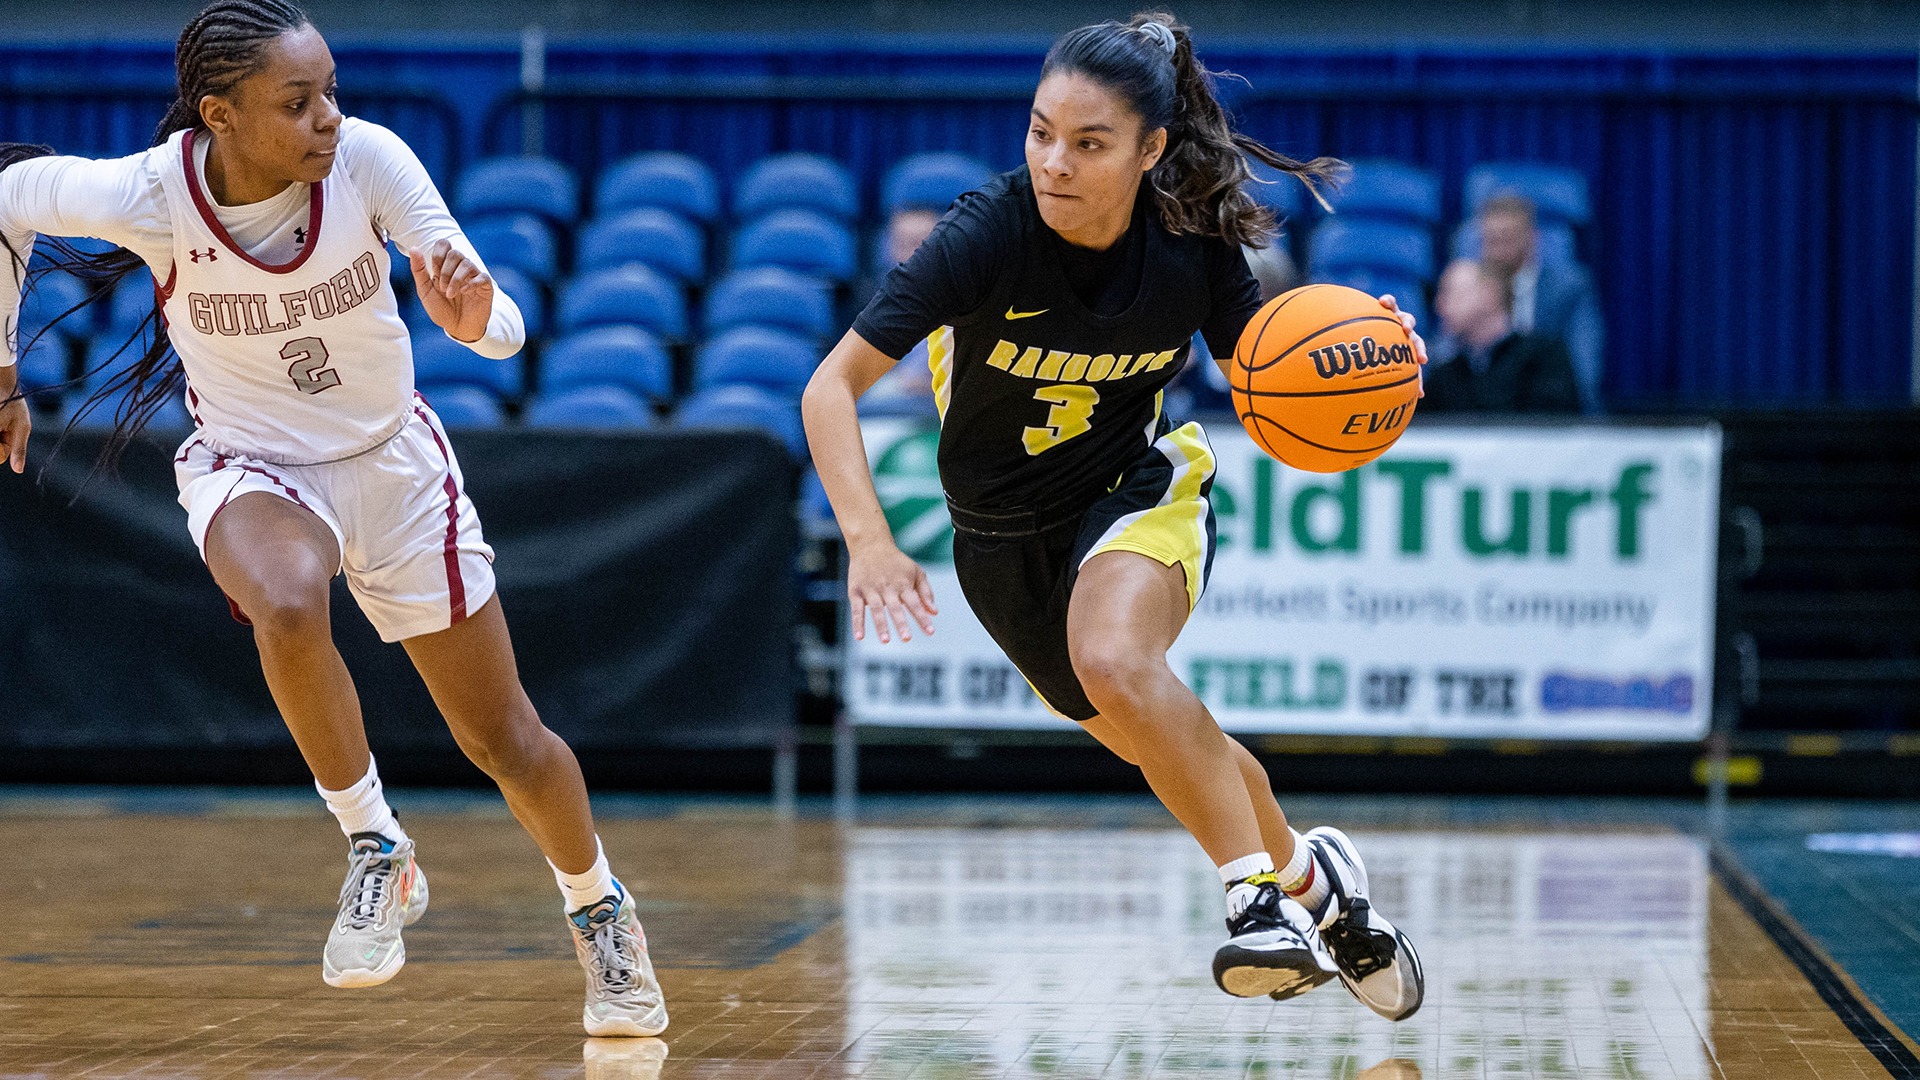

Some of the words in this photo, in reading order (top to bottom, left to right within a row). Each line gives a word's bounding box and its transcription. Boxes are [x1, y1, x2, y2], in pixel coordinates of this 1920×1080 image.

[188, 251, 381, 337] GUILFORD
[279, 336, 342, 395] 2
[1308, 336, 1416, 379] Wilson
[1021, 384, 1100, 456] 3
[1338, 580, 1467, 626] Sports
[1474, 579, 1656, 635] Company
[1189, 656, 1347, 711] FIELD
[1363, 667, 1415, 714] OF
[1435, 668, 1518, 715] THE
